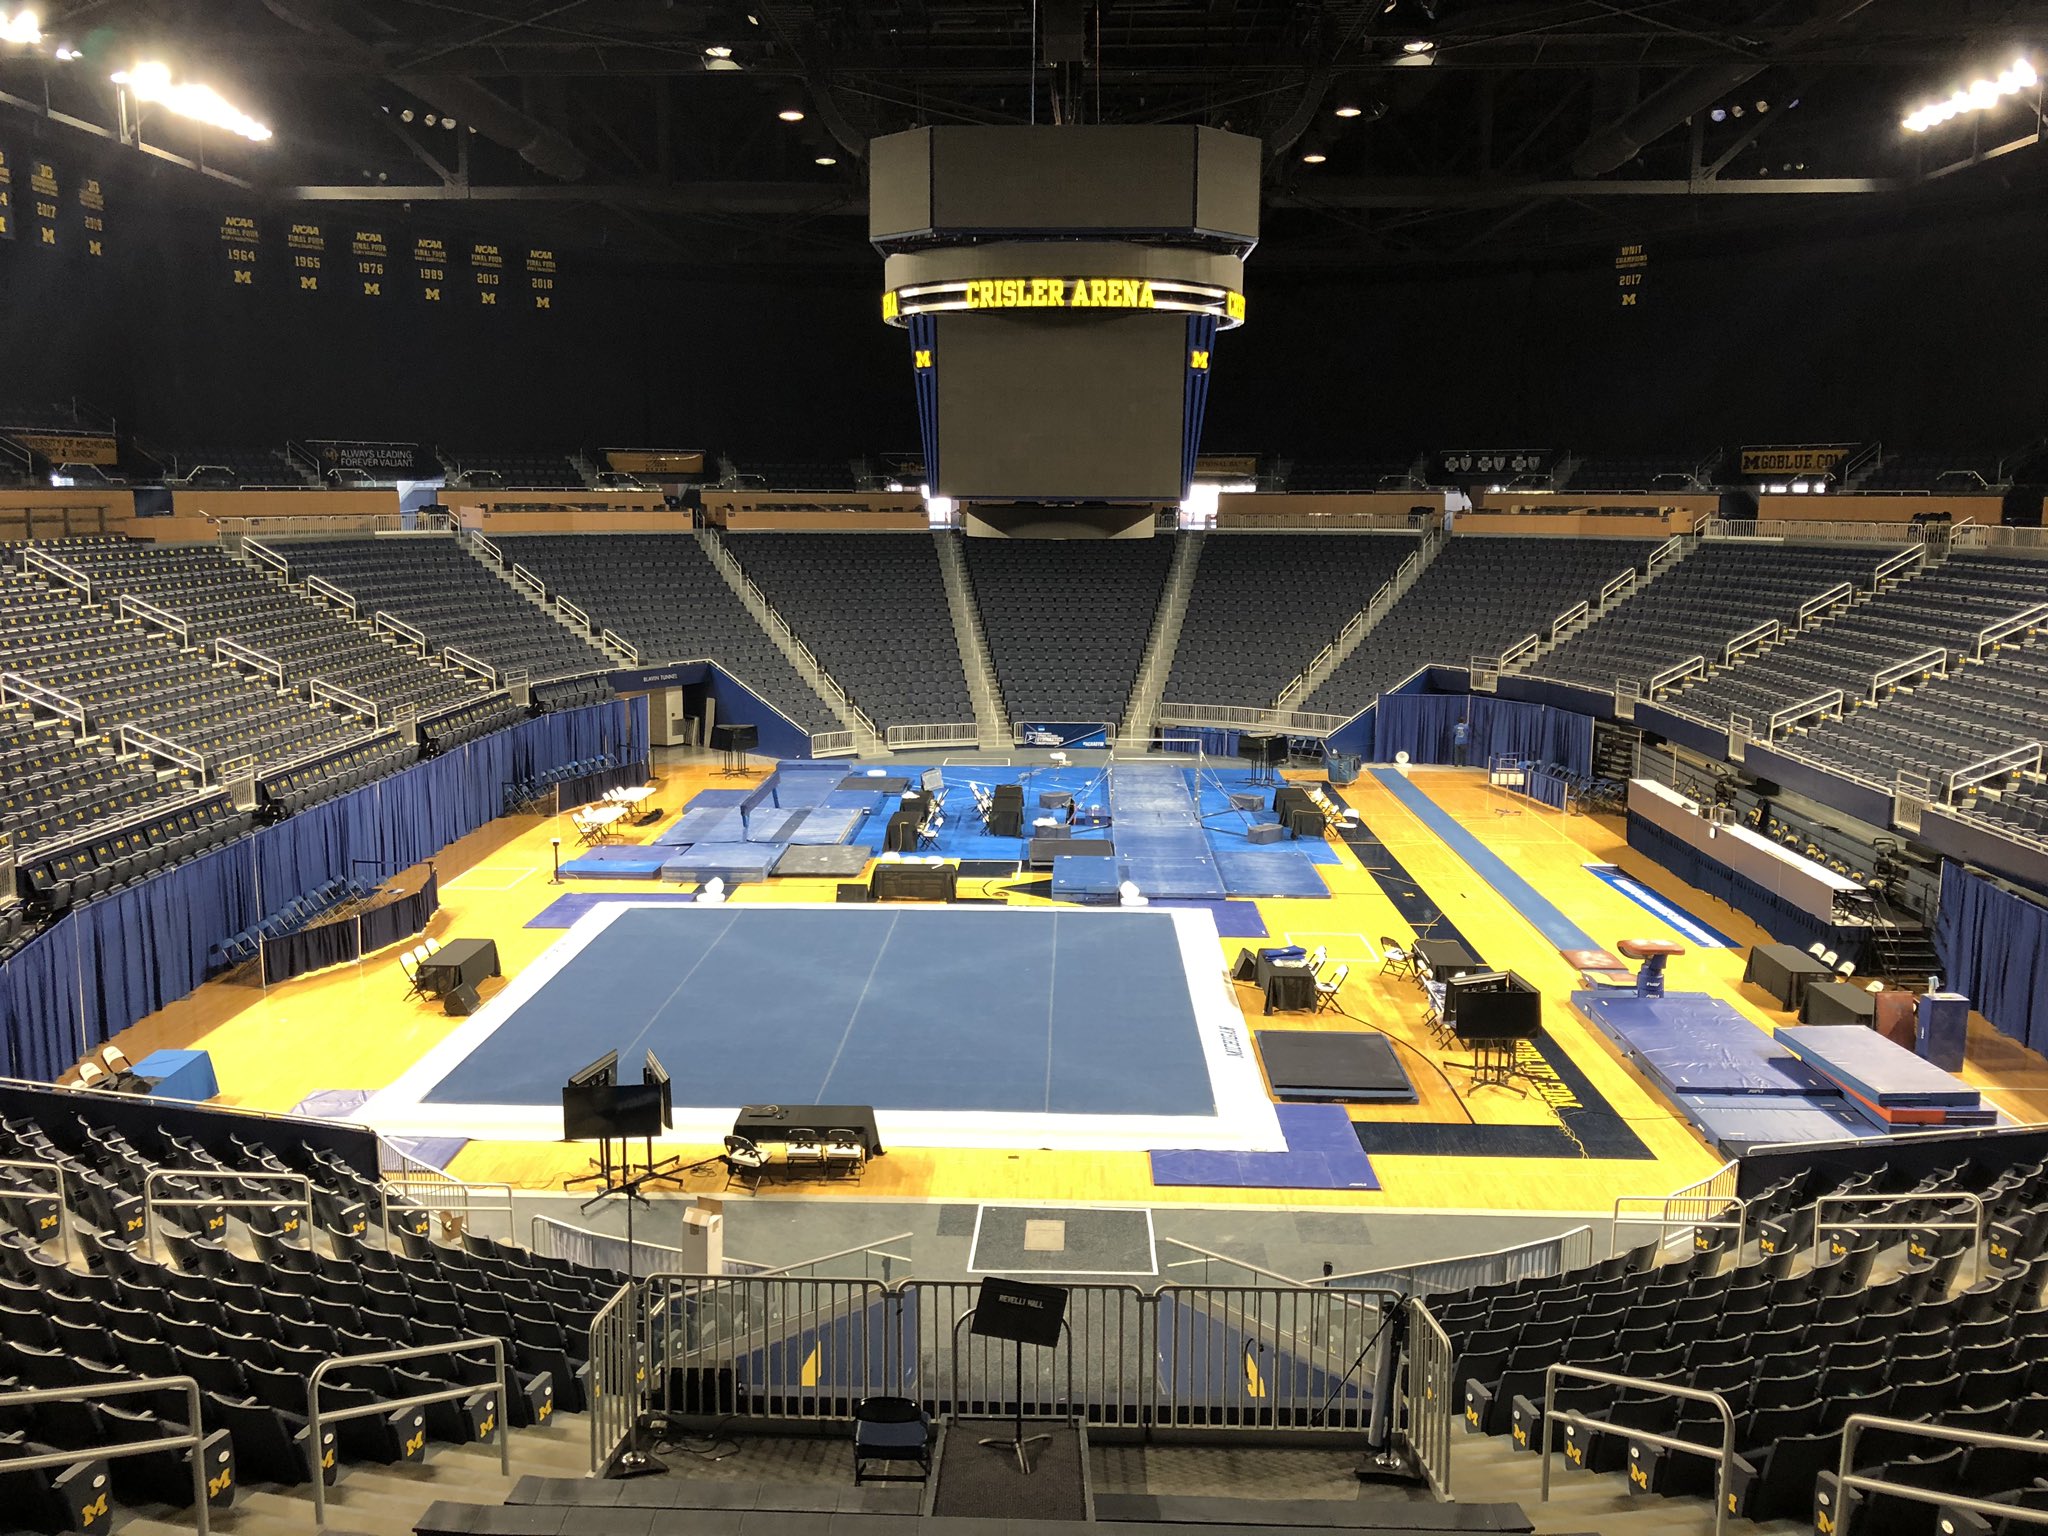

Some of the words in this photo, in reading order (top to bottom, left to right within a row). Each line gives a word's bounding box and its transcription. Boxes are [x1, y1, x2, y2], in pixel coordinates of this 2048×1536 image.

[226, 217, 253, 228] NCAA
[292, 225, 319, 236] NCAA
[356, 232, 382, 242] NCAA
[418, 239, 442, 248] NCAA
[475, 245, 498, 254] NCAA
[228, 250, 256, 262] 1964
[530, 250, 552, 259] NCAA
[295, 256, 320, 268] 1965
[234, 270, 252, 284] M
[300, 277, 318, 290] M
[477, 274, 498, 284] 2013
[1620, 274, 1641, 286] 2017
[364, 282, 380, 295] M
[426, 288, 440, 300] M
[966, 280, 1064, 308] CRISLER
[1072, 280, 1155, 308] ARENA
[482, 292, 496, 304] M
[536, 297, 550, 308] M
[1622, 294, 1636, 306] M
[916, 350, 931, 368] M
[1192, 350, 1208, 369] M
[341, 450, 374, 458] ALWAYS
[41, 1216, 57, 1229] M
[128, 1217, 143, 1231] M
[210, 1216, 224, 1229] M
[284, 1220, 298, 1232] M
[353, 1221, 365, 1233] M
[416, 1222, 428, 1234] M
[1696, 1237, 1708, 1249] M
[1762, 1239, 1774, 1252] M
[1832, 1243, 1847, 1255] M
[1910, 1243, 1926, 1257] M
[1991, 1243, 2007, 1258] M
[540, 1400, 552, 1421] M
[1467, 1405, 1478, 1426] M
[480, 1414, 494, 1437] M
[1514, 1423, 1526, 1447] M
[407, 1431, 423, 1456] M
[1567, 1440, 1581, 1465] M
[208, 1467, 231, 1498] M
[1631, 1463, 1647, 1489] M
[82, 1493, 108, 1527] M
